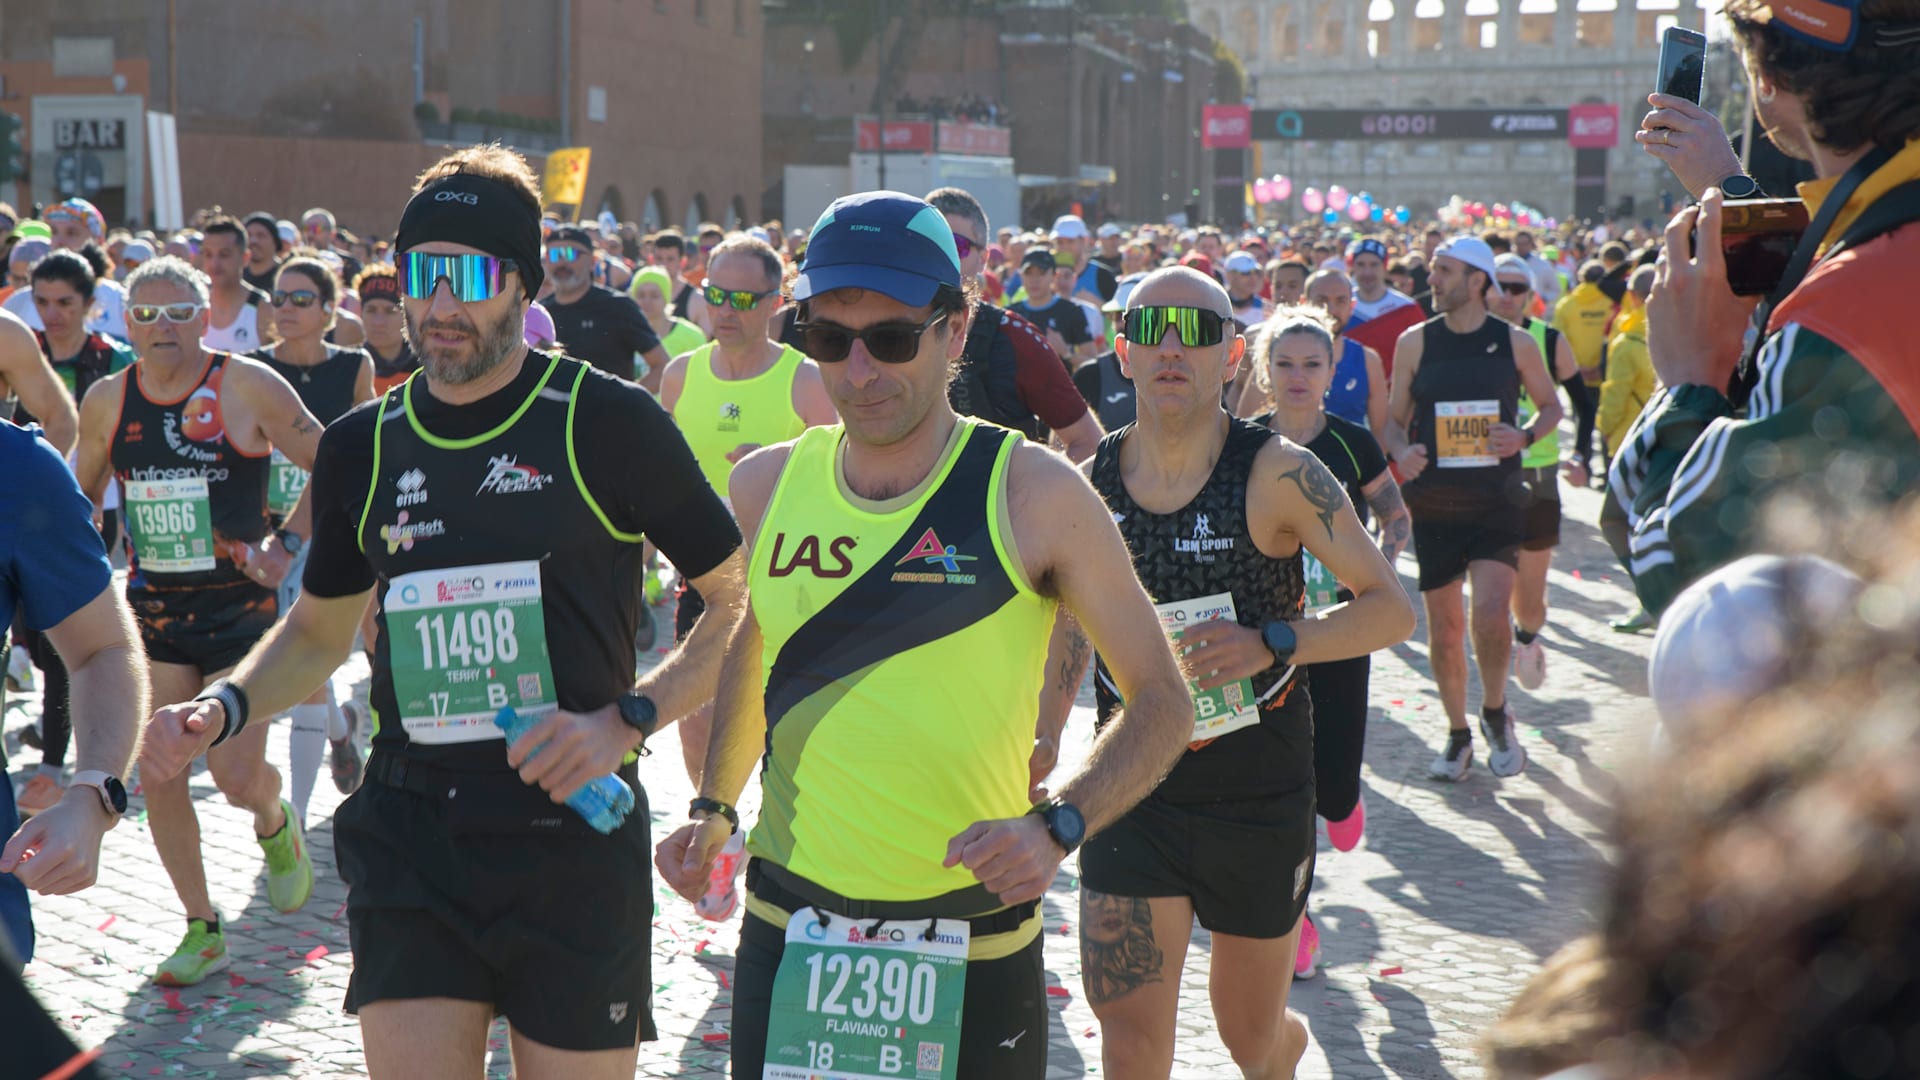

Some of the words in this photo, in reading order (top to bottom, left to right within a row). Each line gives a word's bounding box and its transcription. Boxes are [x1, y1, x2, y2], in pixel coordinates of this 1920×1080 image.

[56, 119, 119, 147] BAR
[850, 224, 881, 233] KIPRUN
[135, 501, 197, 535] 13966
[174, 543, 187, 558] B
[768, 532, 858, 579] LAS
[1174, 537, 1200, 554] LBM
[1201, 537, 1235, 552] SPORT
[945, 573, 977, 585] TEAM
[415, 608, 519, 670] 11498
[446, 668, 481, 683] TERRY
[428, 690, 450, 719] 17
[487, 682, 509, 710] B
[1198, 696, 1217, 718] B
[924, 955, 948, 964] MARZO
[805, 951, 937, 1025] 12390
[826, 1018, 888, 1038] FLAVIANO
[807, 1040, 834, 1070] 18
[879, 1044, 902, 1073] B
